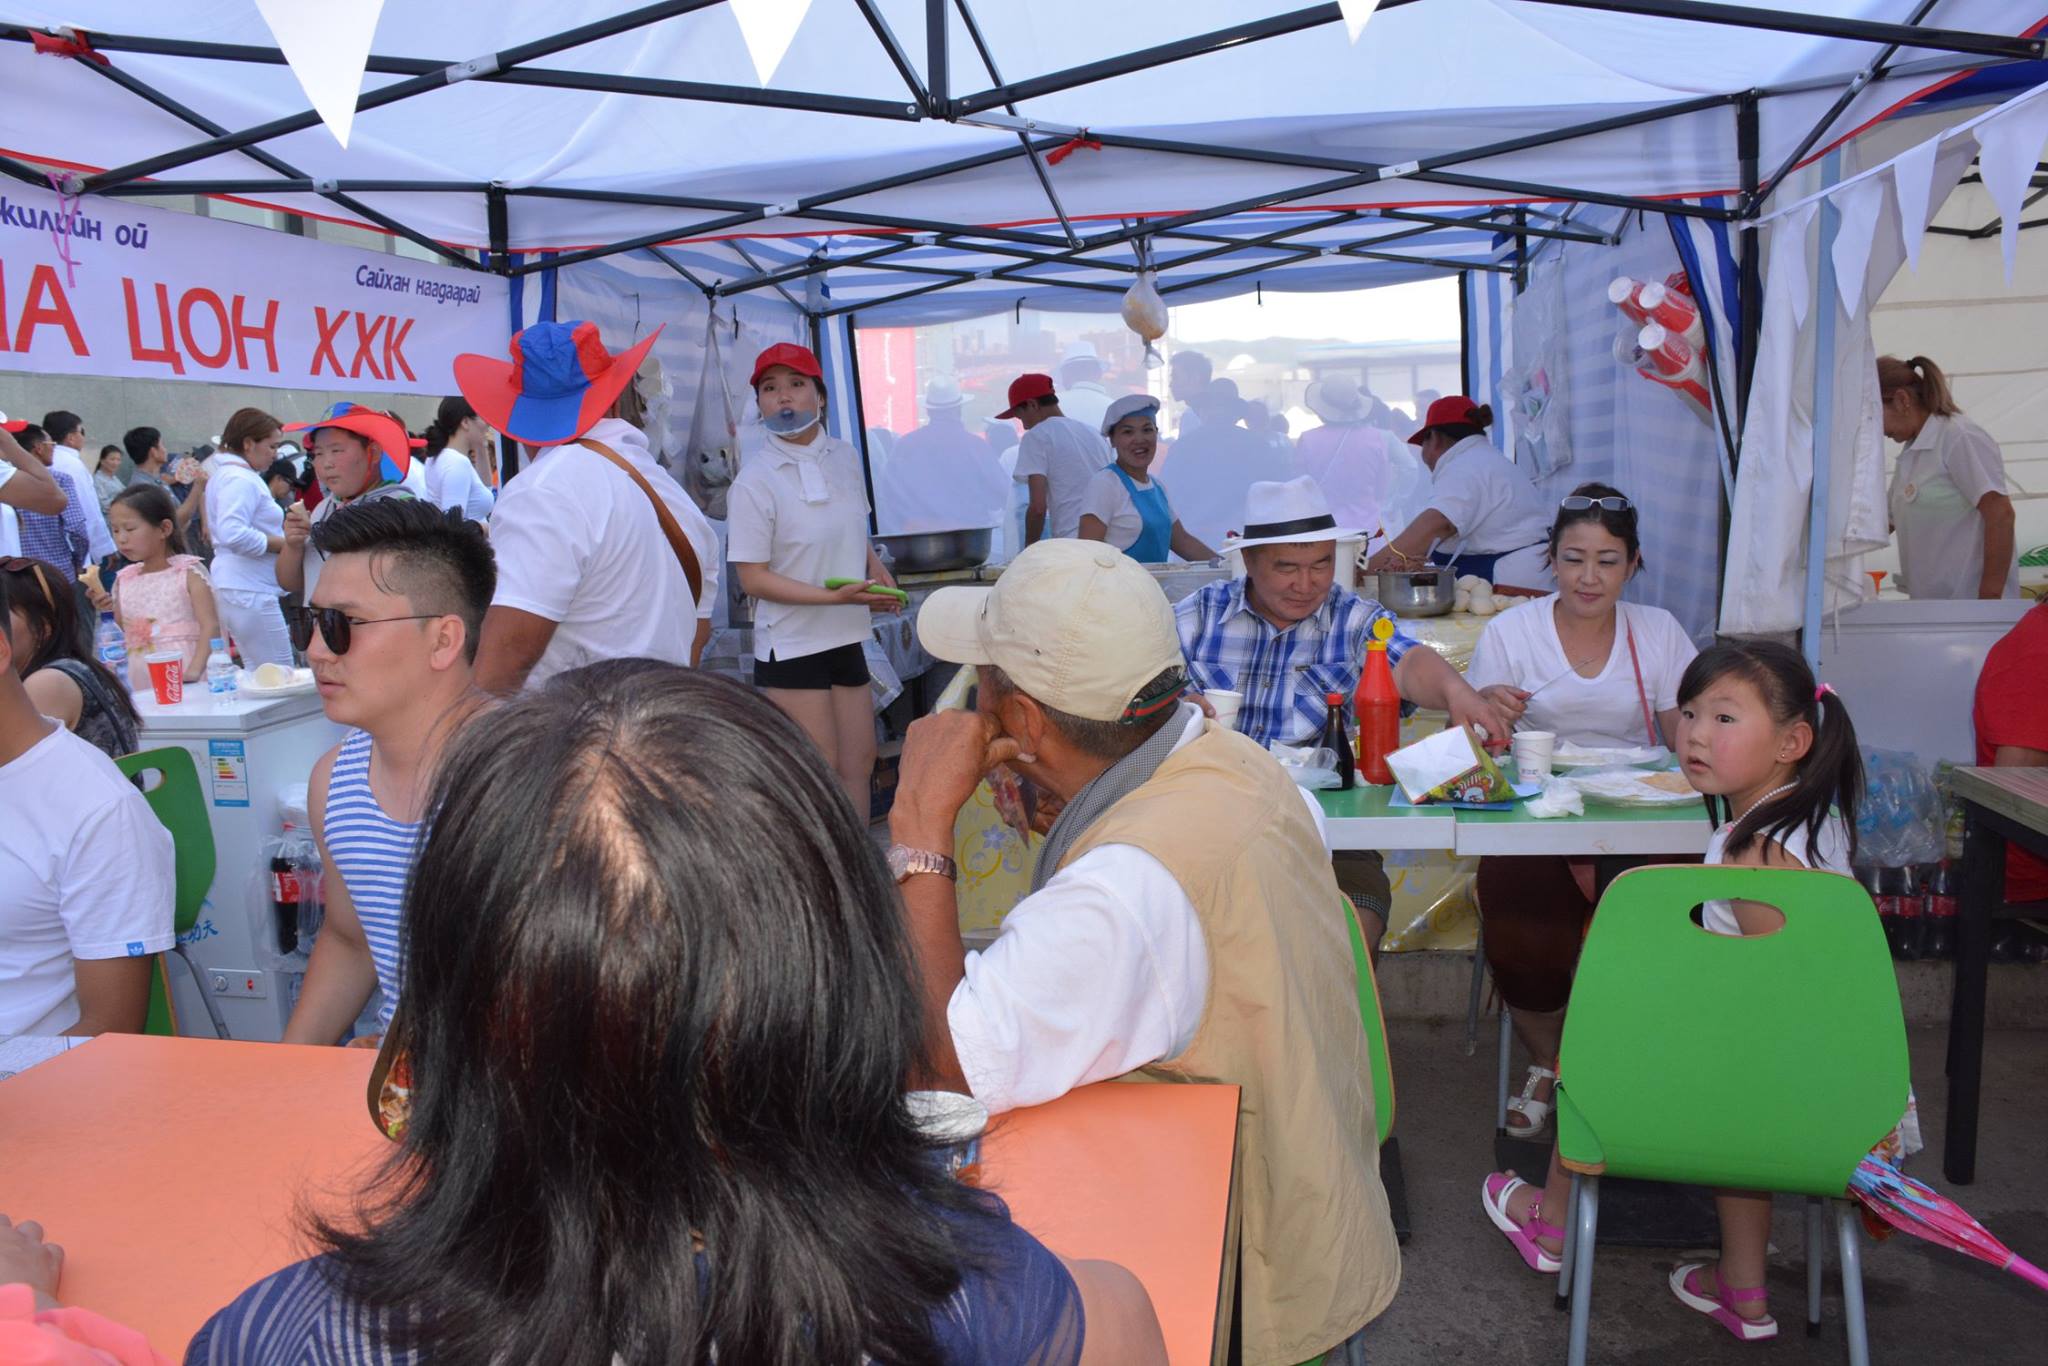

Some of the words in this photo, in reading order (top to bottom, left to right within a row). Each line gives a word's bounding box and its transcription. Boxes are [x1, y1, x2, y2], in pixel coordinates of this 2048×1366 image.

[115, 222, 149, 249] ой
[356, 264, 411, 293] Сайхан
[415, 279, 481, 307] наадаарай
[0, 258, 91, 356] А
[121, 276, 280, 375] ЦОН
[310, 306, 418, 383] ХХК
